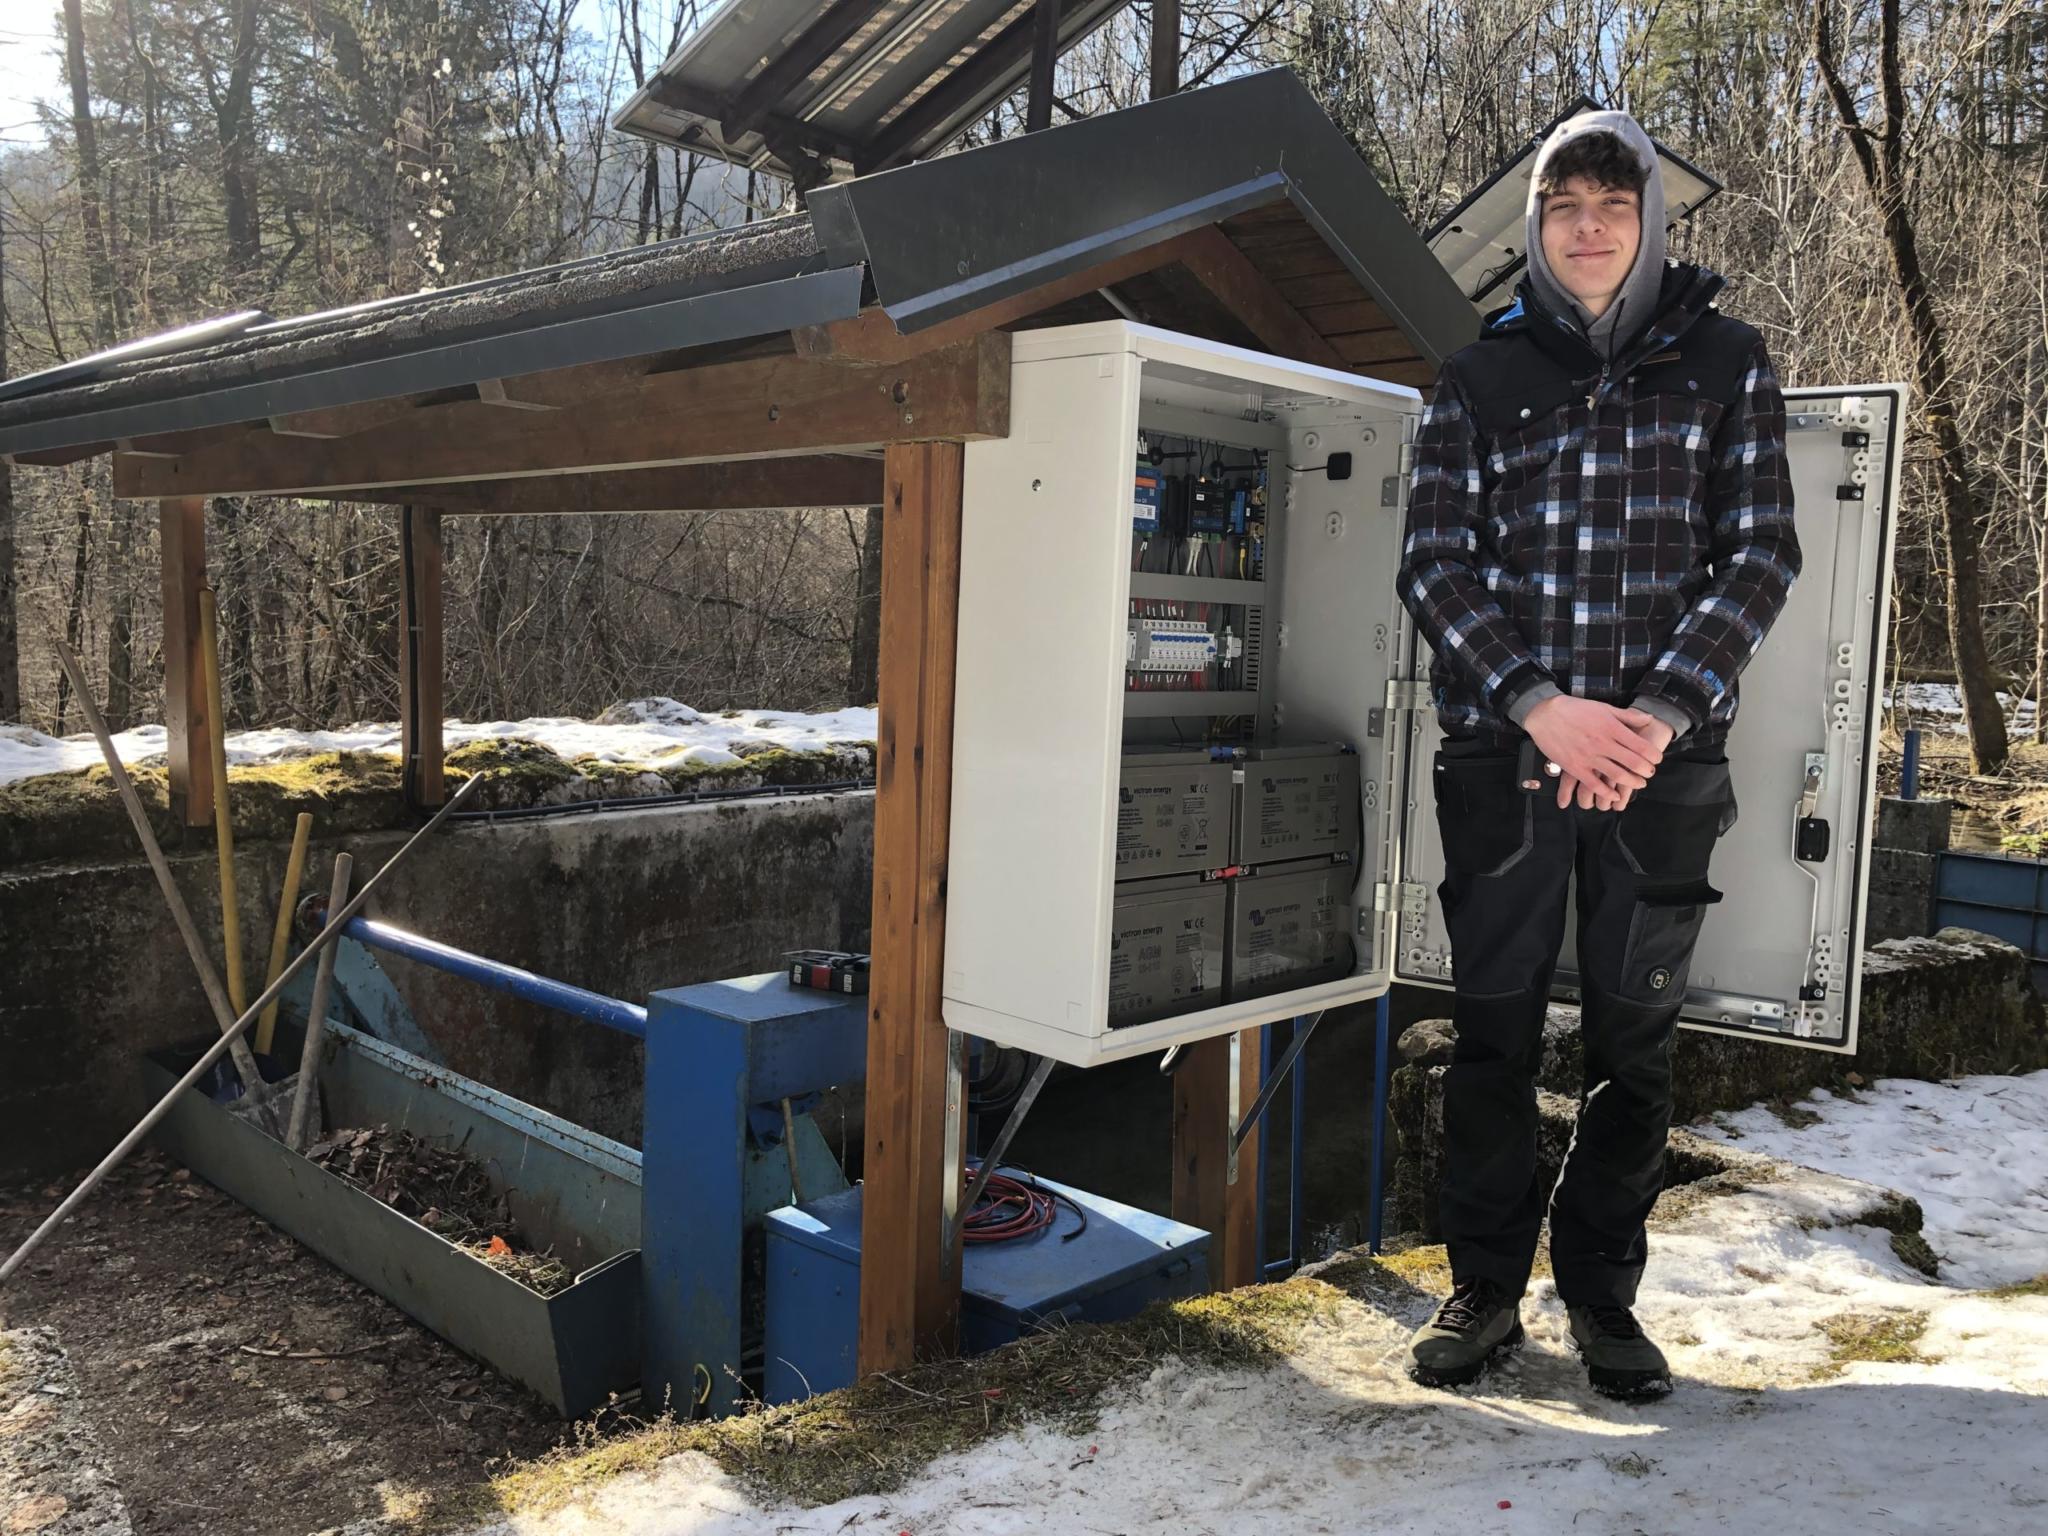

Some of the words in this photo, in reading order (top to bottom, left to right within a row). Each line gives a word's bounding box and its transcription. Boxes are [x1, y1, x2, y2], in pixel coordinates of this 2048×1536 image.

[1153, 786, 1172, 795] energy
[1120, 928, 1141, 938] victron
[1142, 926, 1163, 936] energy
